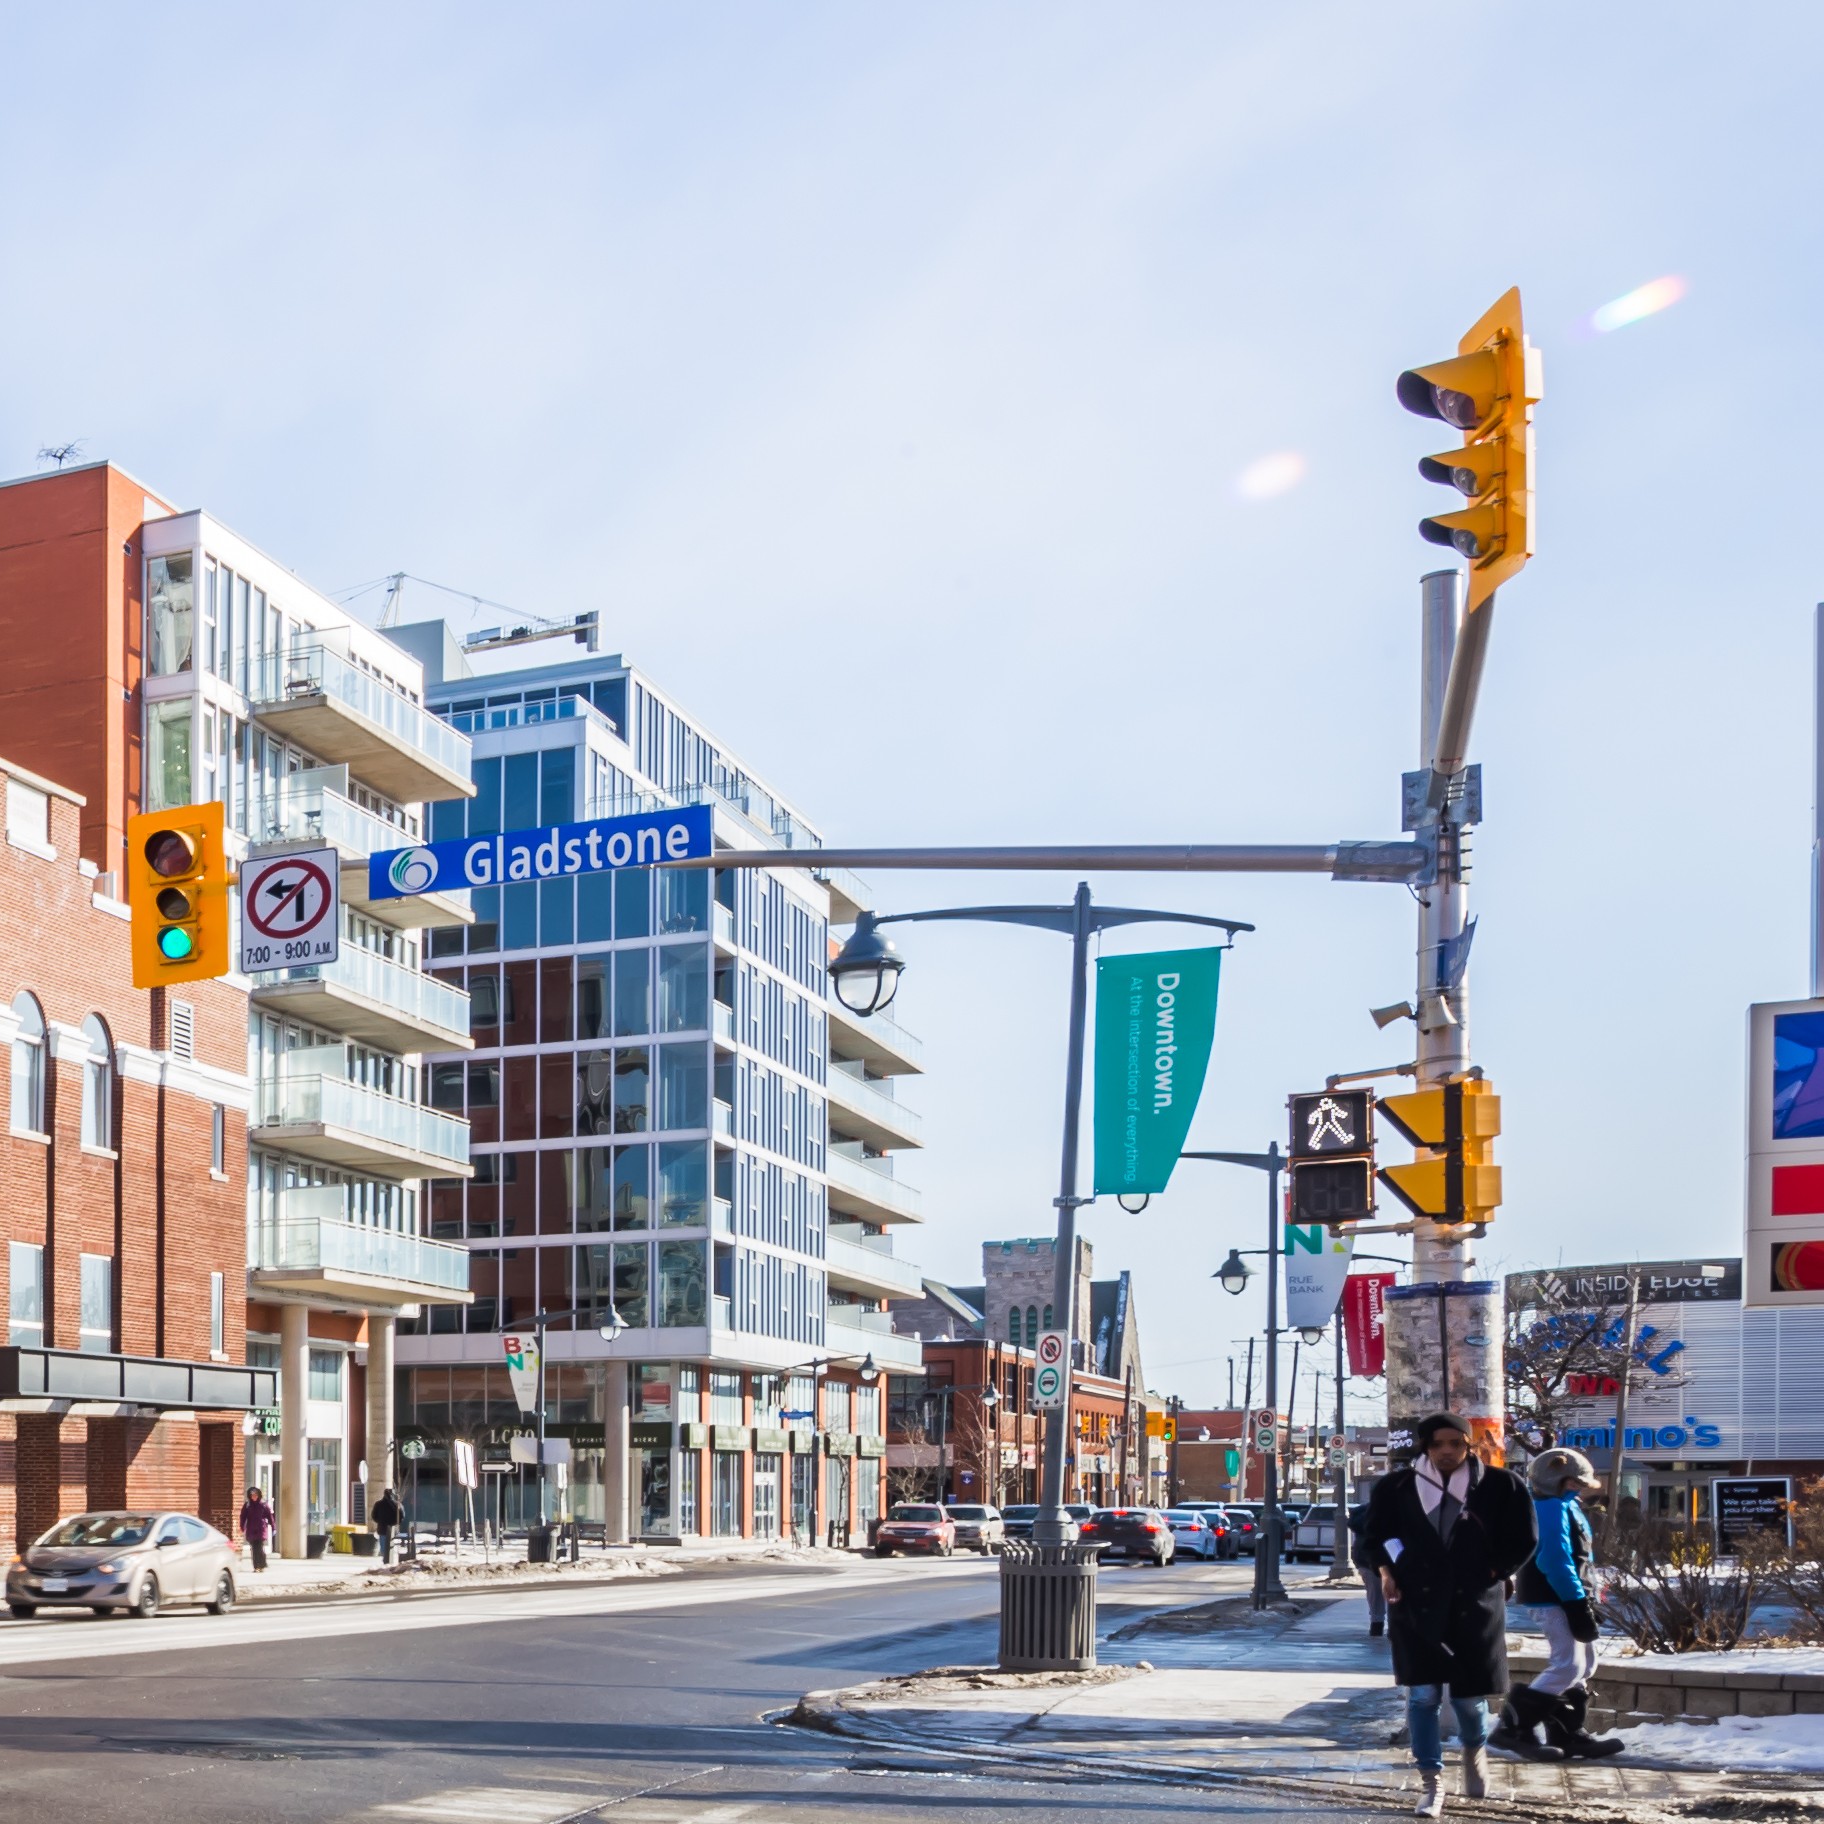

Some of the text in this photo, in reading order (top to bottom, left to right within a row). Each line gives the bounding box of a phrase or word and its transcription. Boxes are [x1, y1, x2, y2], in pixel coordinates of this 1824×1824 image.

[464, 824, 690, 885] Gladstone
[246, 945, 270, 964] 7:00
[285, 940, 310, 960] 9:00
[1153, 972, 1180, 1115] Downtown.
[1123, 976, 1143, 1185] At the intersection of everything.
[1289, 1275, 1314, 1284] RUE
[1289, 1285, 1324, 1295] BANK
[1576, 1274, 1719, 1294] INSID EDGE
